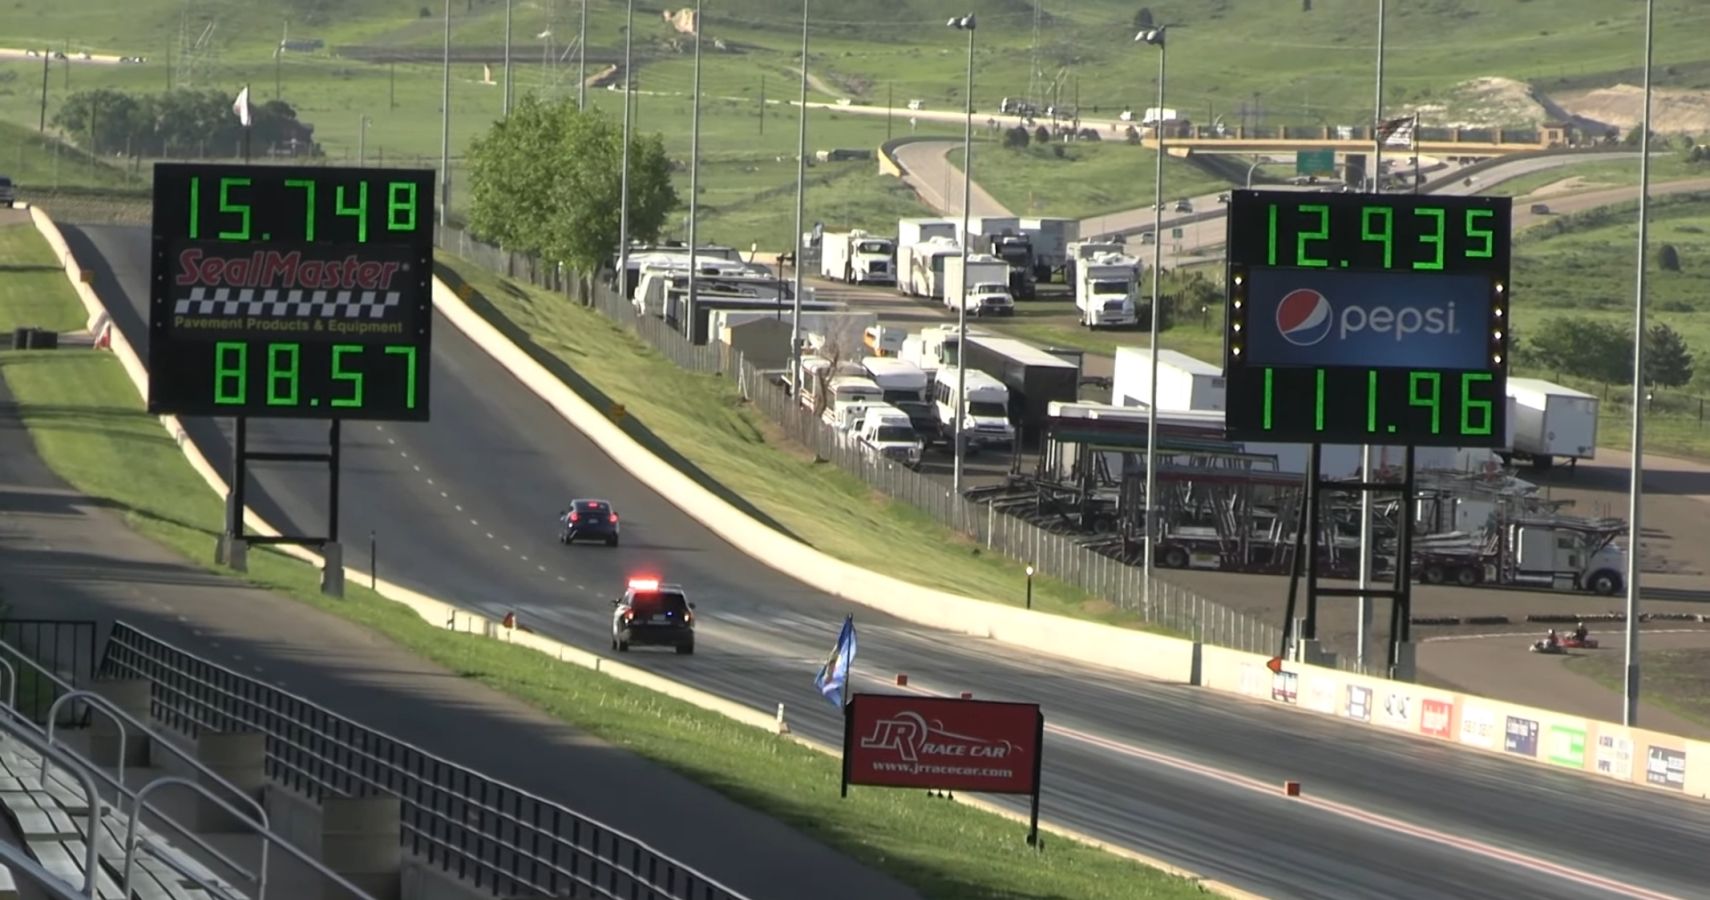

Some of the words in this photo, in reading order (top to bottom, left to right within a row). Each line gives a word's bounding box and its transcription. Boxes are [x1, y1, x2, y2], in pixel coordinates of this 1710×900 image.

[189, 177, 417, 242] 15.748
[1267, 204, 1494, 269] 12.935
[174, 316, 243, 330] Pavement
[247, 317, 309, 332] Products
[313, 319, 324, 332] &
[328, 319, 403, 335] Equipment
[1340, 302, 1457, 341] pepsi
[214, 342, 417, 408] 88.57
[1263, 367, 1494, 435] 111.96
[860, 719, 919, 762] JR
[921, 743, 967, 757] RACE
[970, 745, 1007, 759] CAR
[872, 760, 1014, 779] www.jrracecar.com
